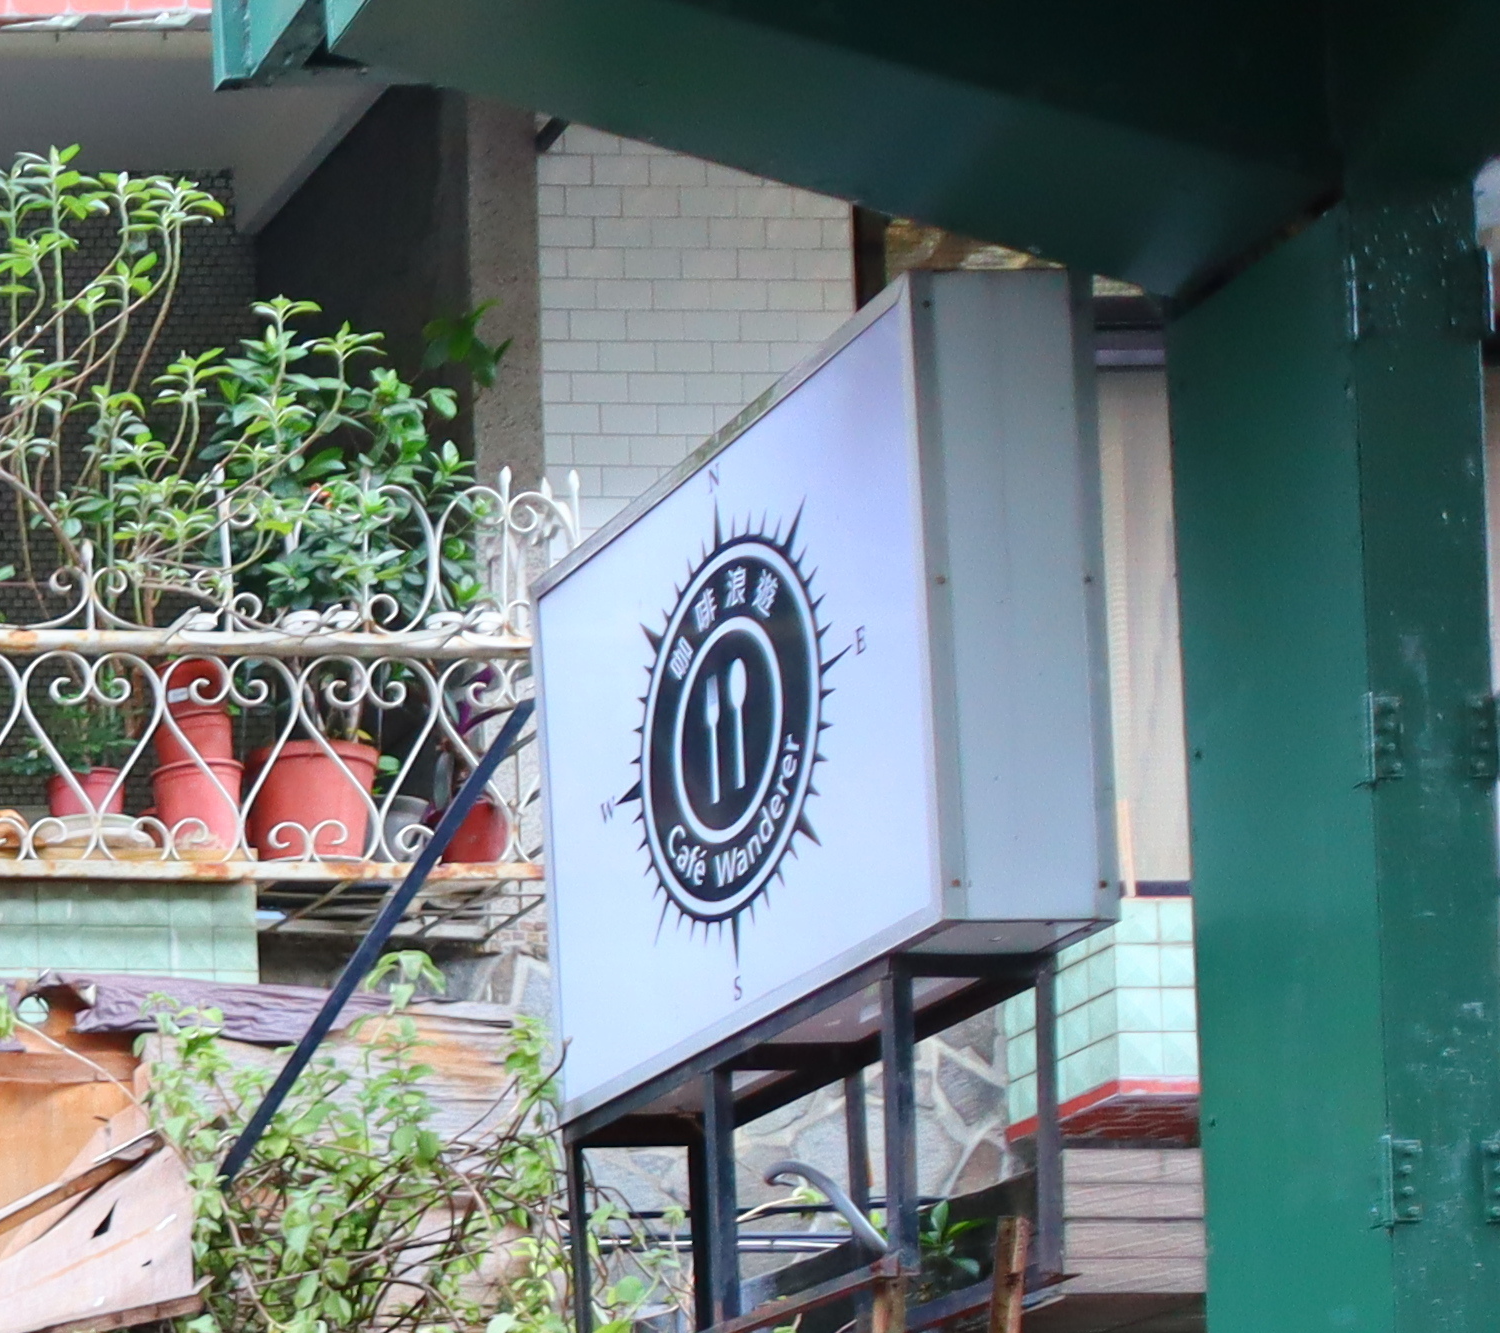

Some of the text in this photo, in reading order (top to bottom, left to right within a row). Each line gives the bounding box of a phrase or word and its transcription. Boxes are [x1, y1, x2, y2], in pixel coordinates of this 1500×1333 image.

[706, 464, 720, 494] N
[668, 564, 780, 681] 咖啡浪遊
[855, 625, 867, 655] E
[600, 795, 616, 824] W
[667, 732, 803, 888] Café Wanderer
[734, 976, 742, 1001] S
